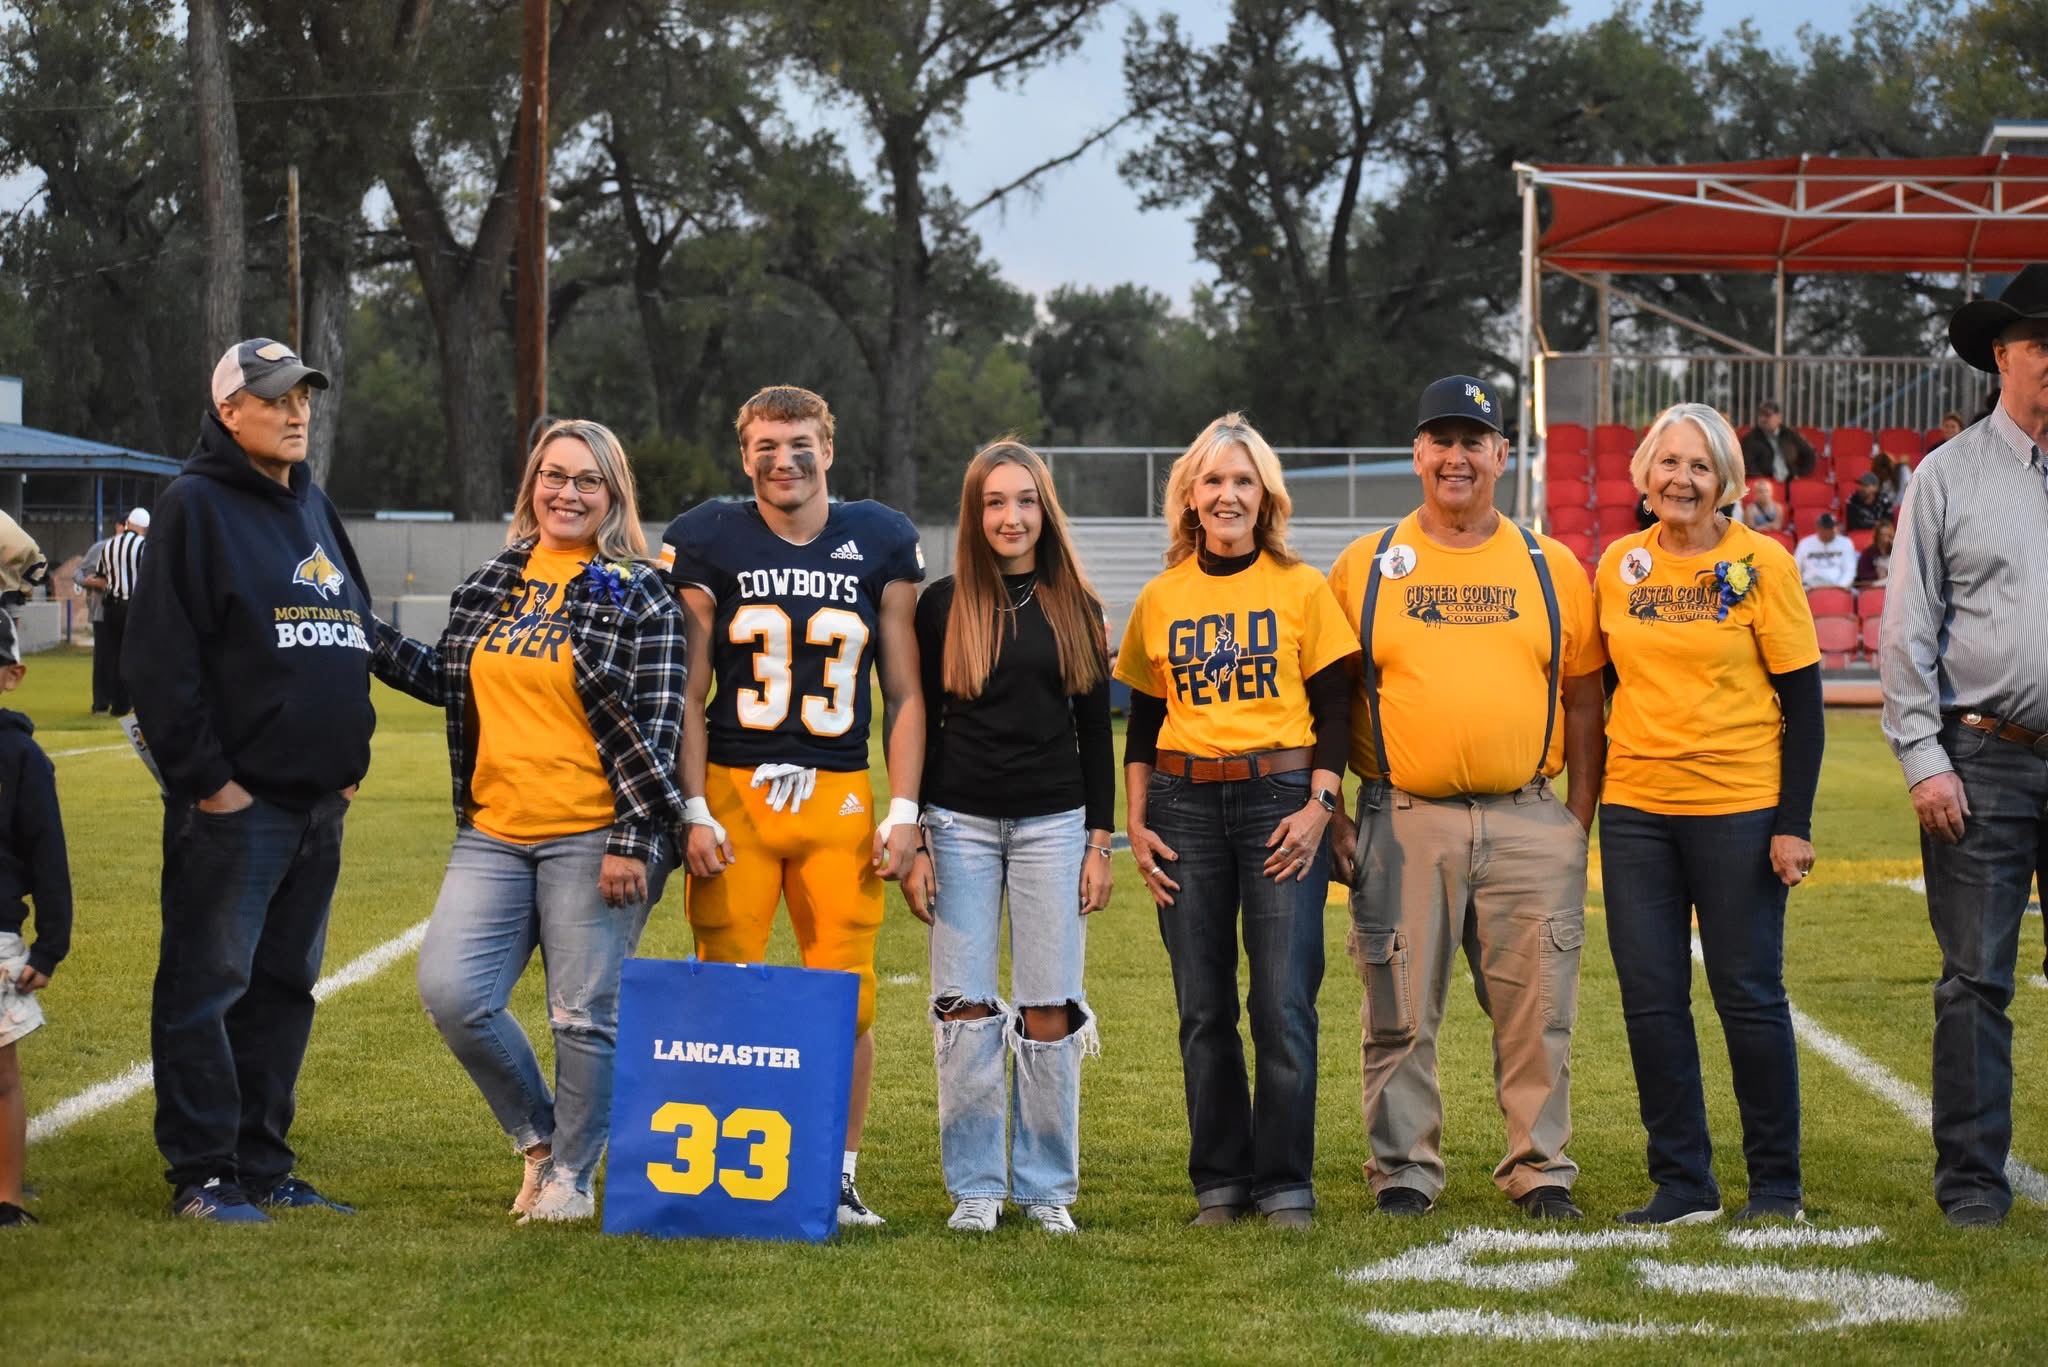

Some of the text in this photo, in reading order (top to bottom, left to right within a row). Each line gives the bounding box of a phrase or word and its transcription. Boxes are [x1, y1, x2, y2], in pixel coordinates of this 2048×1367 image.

[830, 551, 864, 561] adidas
[737, 568, 860, 604] COWBOYS
[1404, 585, 1517, 609] CUSTER COUNTY
[1628, 585, 1721, 607] CUSTER COUNT
[274, 606, 342, 621] MONTANA
[1446, 604, 1510, 613] COWBOYS
[1446, 614, 1510, 623] COWGIRLS
[484, 618, 570, 663] EVER
[1168, 608, 1278, 666] GOLD
[728, 604, 870, 738] 33
[1171, 655, 1280, 706] FEVER
[653, 1039, 800, 1069] LANCASTER
[646, 1101, 792, 1202] 33
